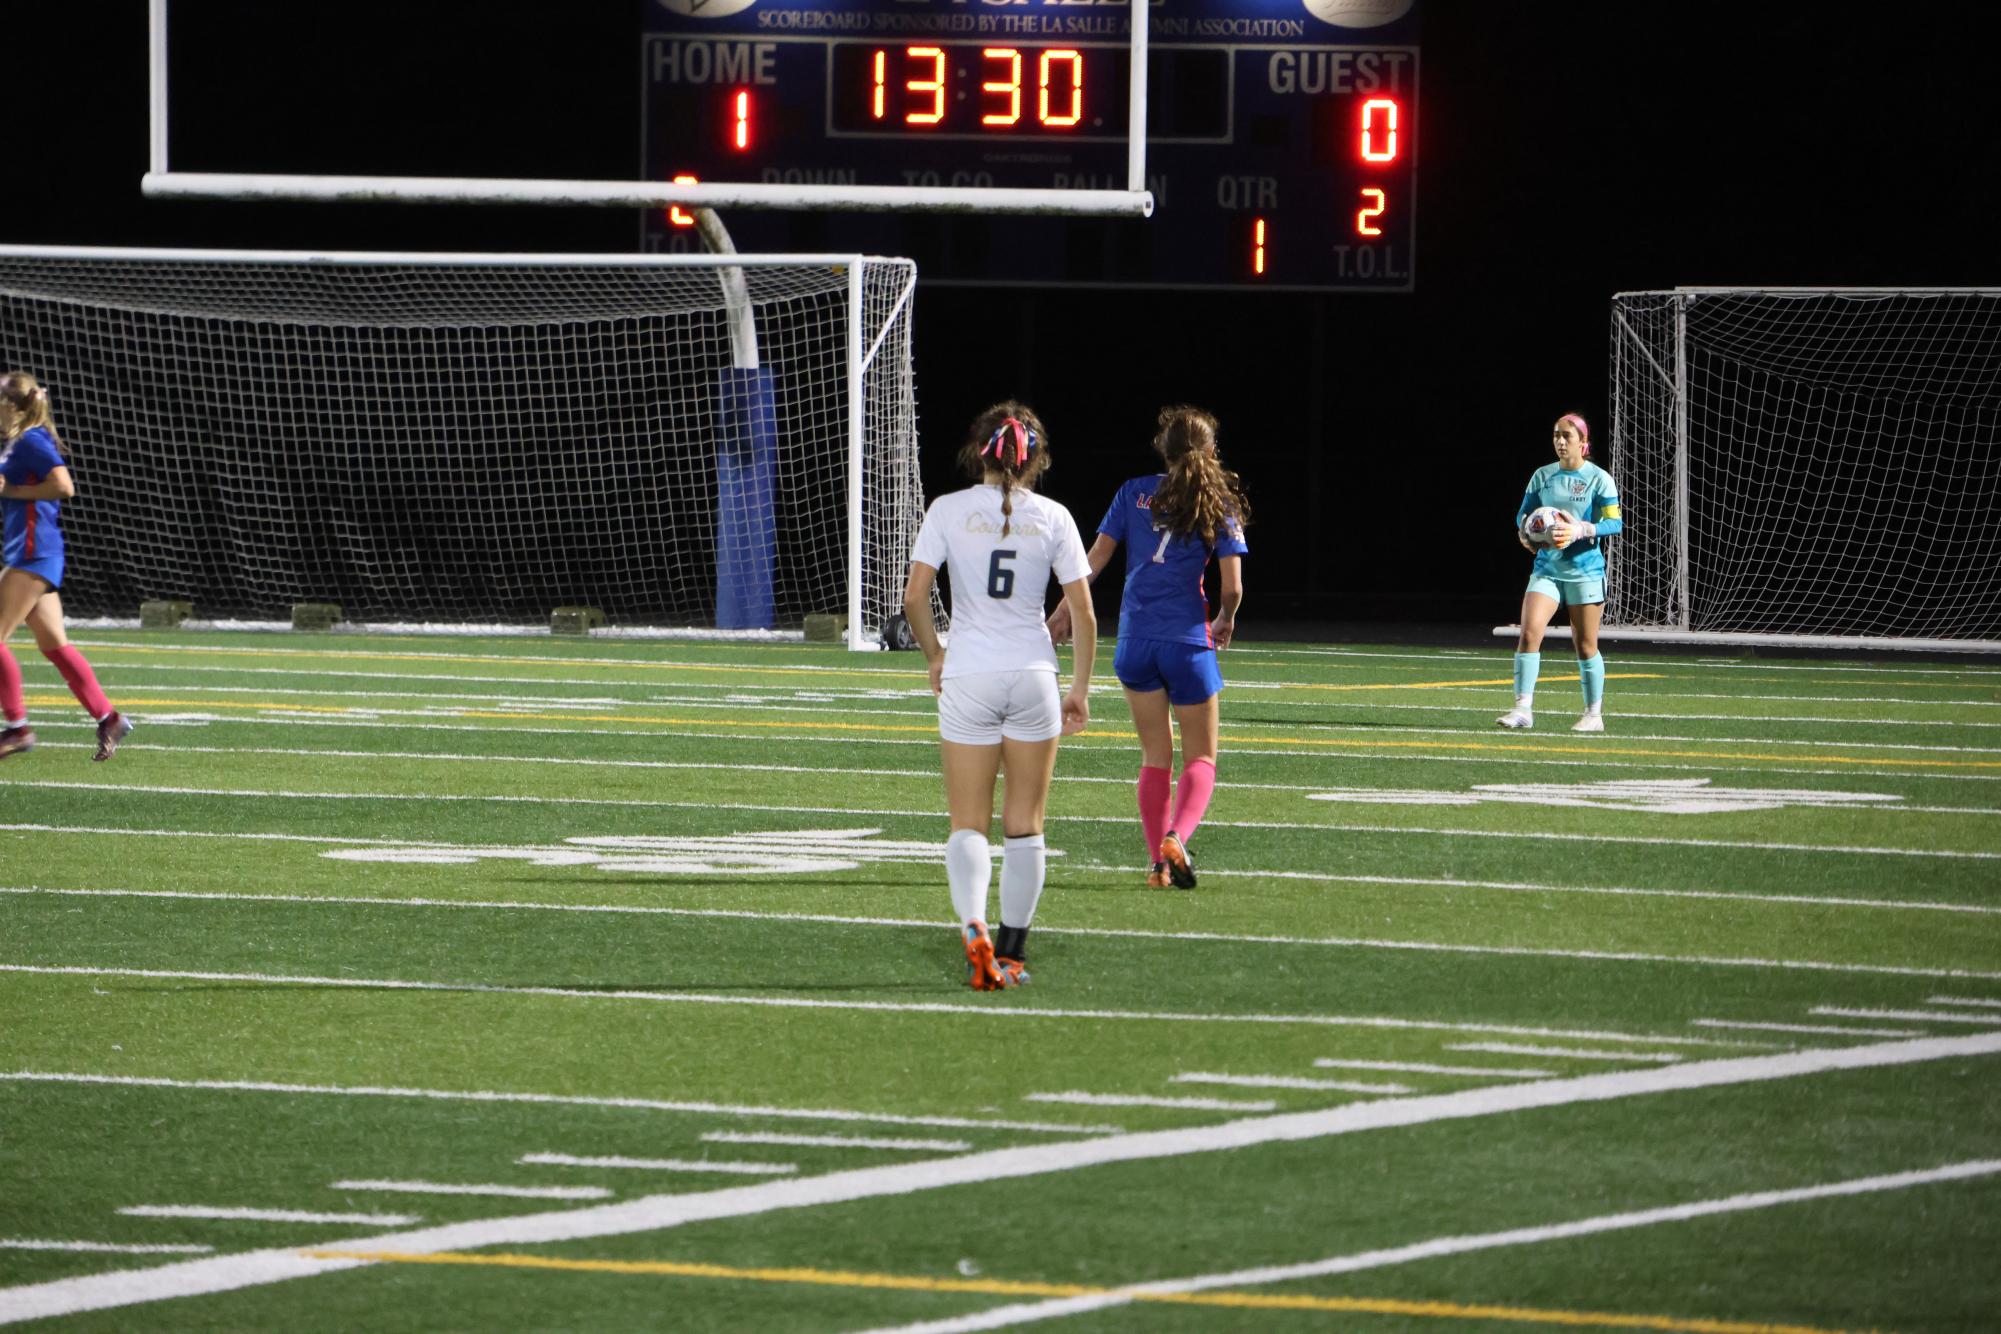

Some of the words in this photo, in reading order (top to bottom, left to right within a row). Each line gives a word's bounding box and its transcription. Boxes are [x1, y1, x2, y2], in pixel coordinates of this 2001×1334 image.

[757, 10, 870, 29] SCOREBOARD
[874, 13, 975, 32] SPONSORED
[978, 15, 1001, 32] BY
[1002, 15, 1037, 33] THE
[1041, 16, 1062, 33] LA
[1066, 17, 1116, 34] SALLE
[1192, 19, 1304, 37] ASSOCIATION
[653, 41, 777, 85] HOME
[1268, 51, 1408, 94] GUEST
[736, 91, 748, 148] 1
[1361, 98, 1398, 162] 0
[1217, 174, 1278, 209] QTR
[1357, 187, 1385, 236] 2
[1255, 218, 1265, 274] 1
[1333, 245, 1409, 278] T.O.L.
[1152, 523, 1176, 563] 7
[987, 549, 1017, 599] 6
